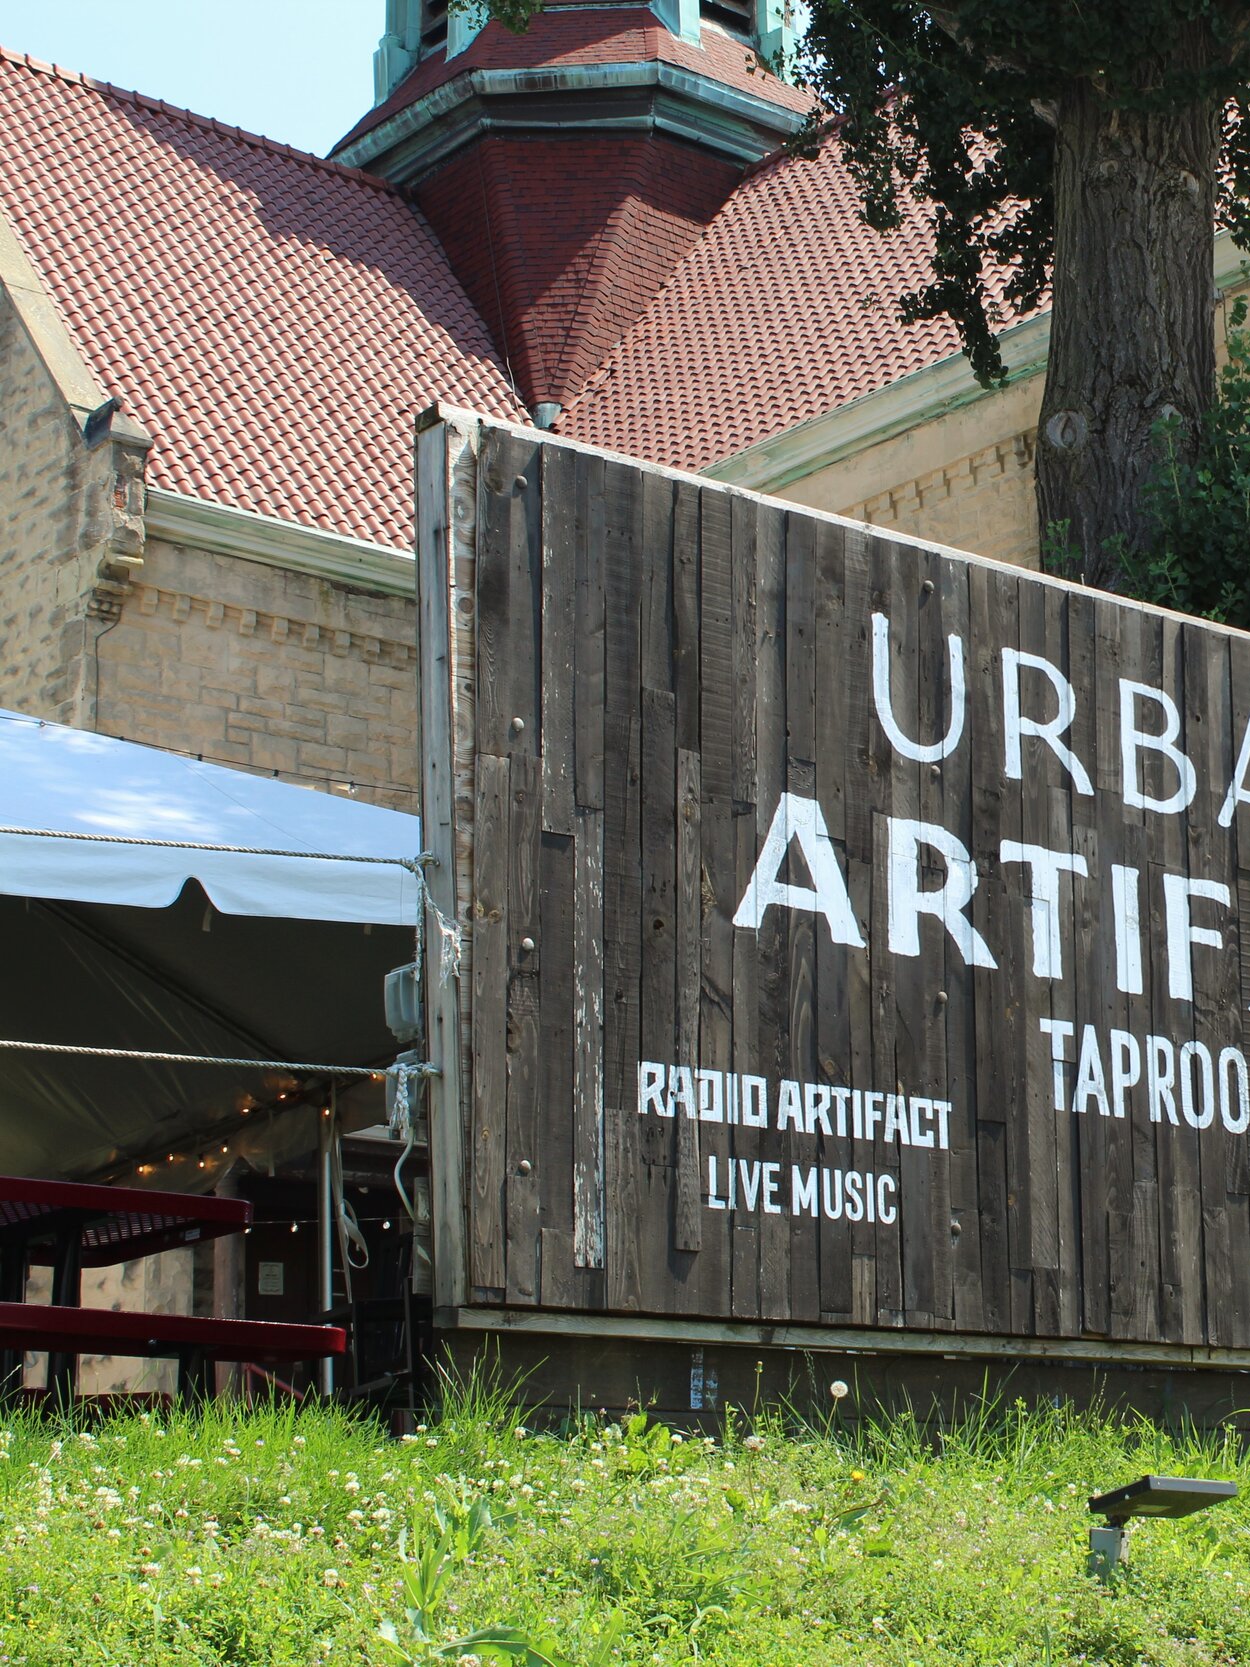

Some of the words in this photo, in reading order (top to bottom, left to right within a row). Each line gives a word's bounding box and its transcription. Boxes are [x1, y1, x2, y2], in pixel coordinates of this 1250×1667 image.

[637, 1061, 767, 1128] RADIO
[777, 1079, 952, 1149] ARTIFACT
[708, 1155, 781, 1214] LIVE
[791, 1164, 896, 1225] MUSIC
